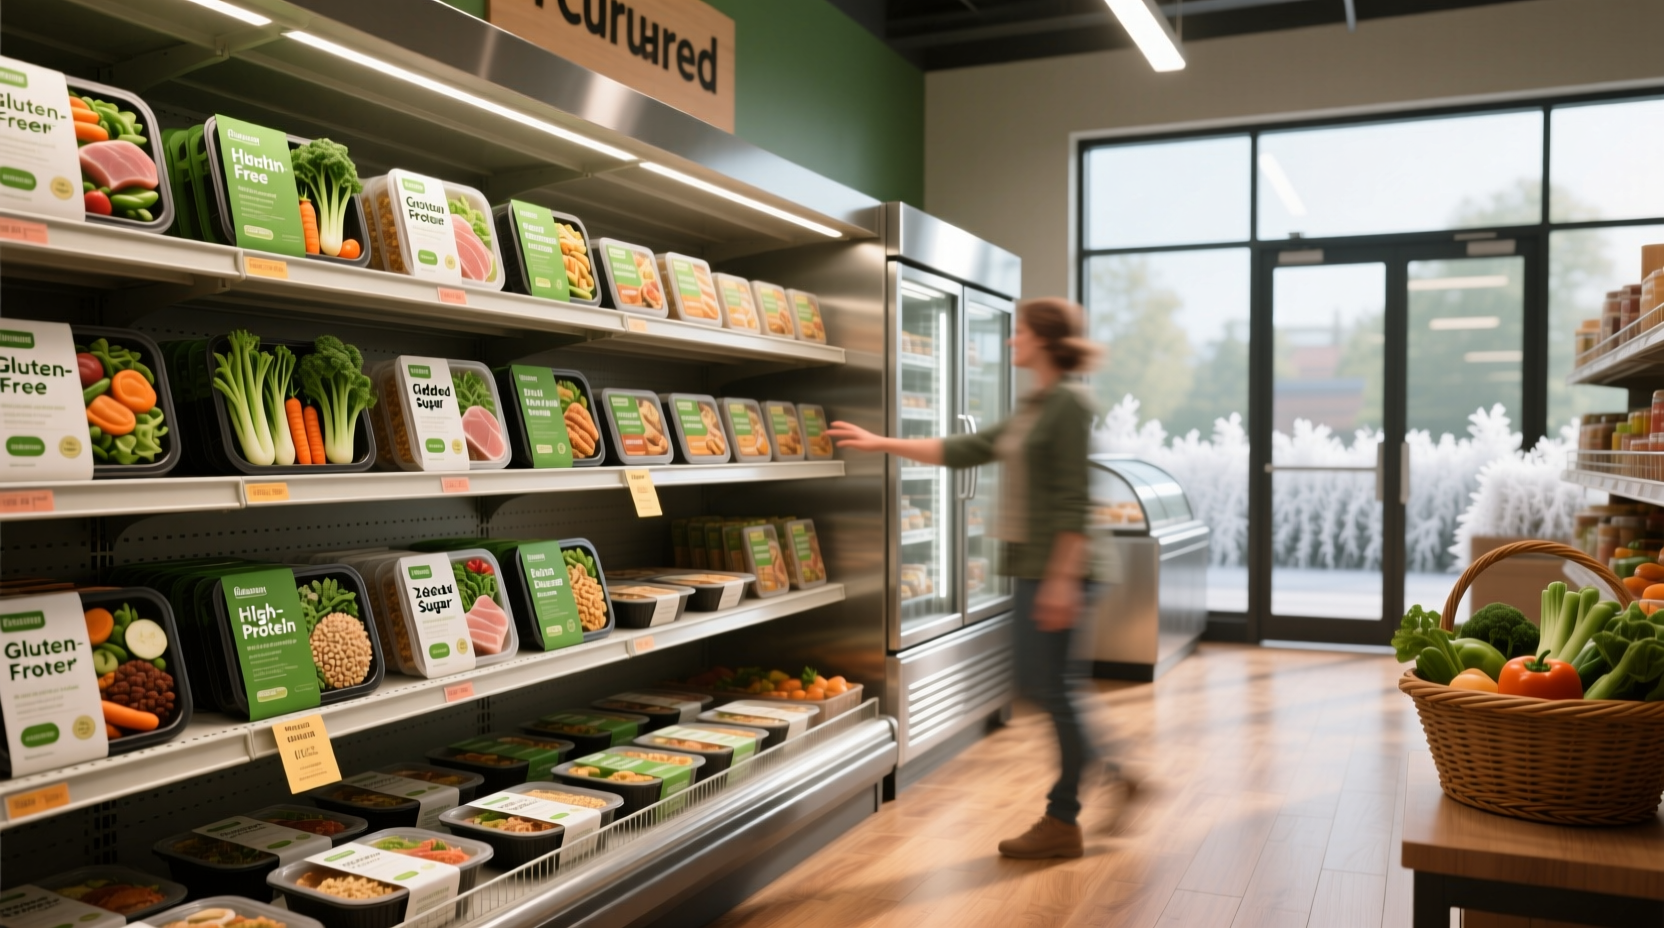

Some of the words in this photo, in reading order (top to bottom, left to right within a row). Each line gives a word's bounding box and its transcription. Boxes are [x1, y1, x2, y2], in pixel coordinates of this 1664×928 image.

[234, 164, 268, 185] Free
[0, 377, 47, 395] Free
[4, 638, 84, 659] Gluten-
